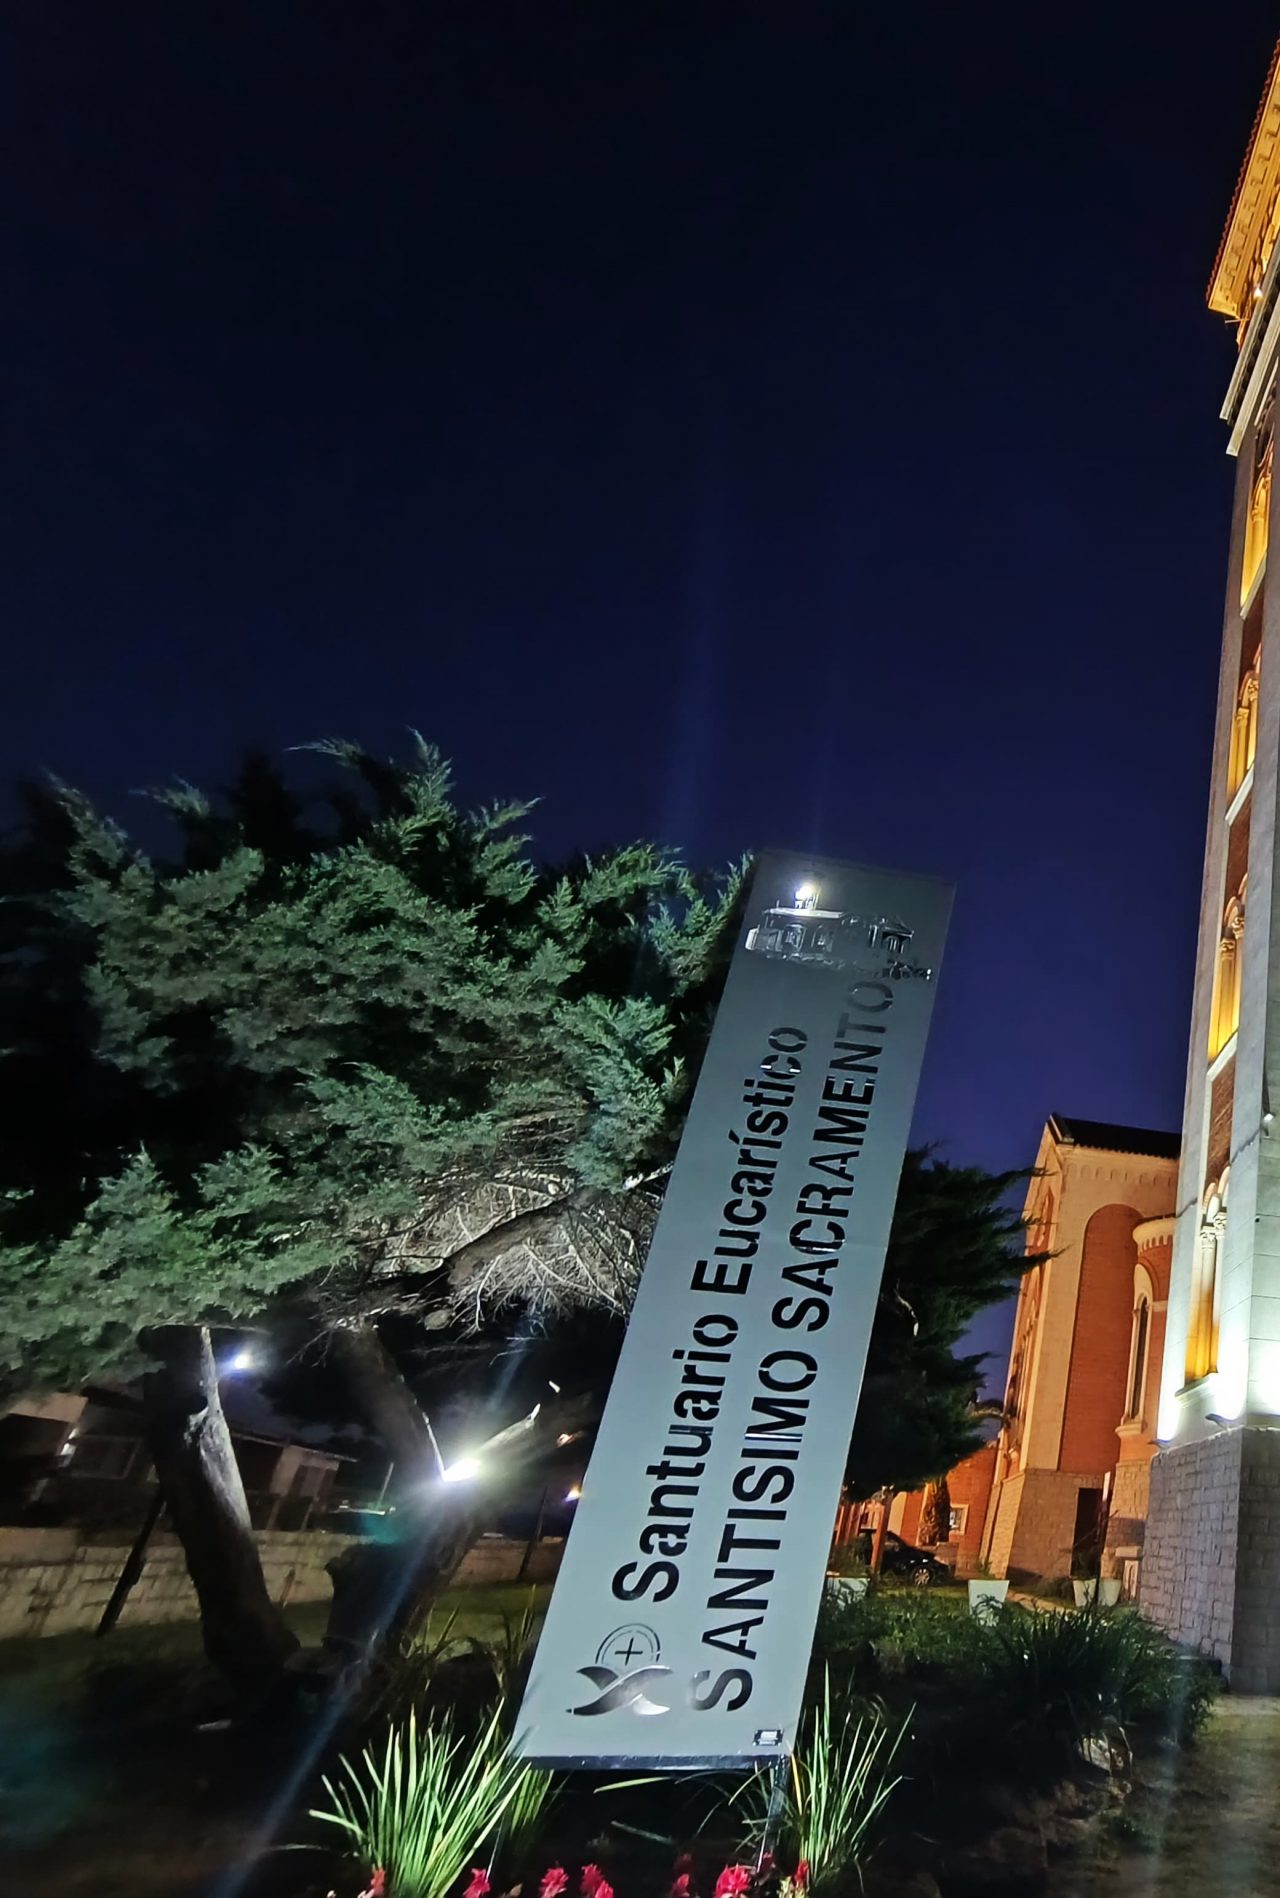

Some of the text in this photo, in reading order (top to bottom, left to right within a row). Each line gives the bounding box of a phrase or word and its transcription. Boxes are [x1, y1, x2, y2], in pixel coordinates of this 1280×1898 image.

[612, 1027, 808, 1602] Santuario Eucarístico
[690, 981, 894, 1711] SANTISIMO SACRAMENTO
